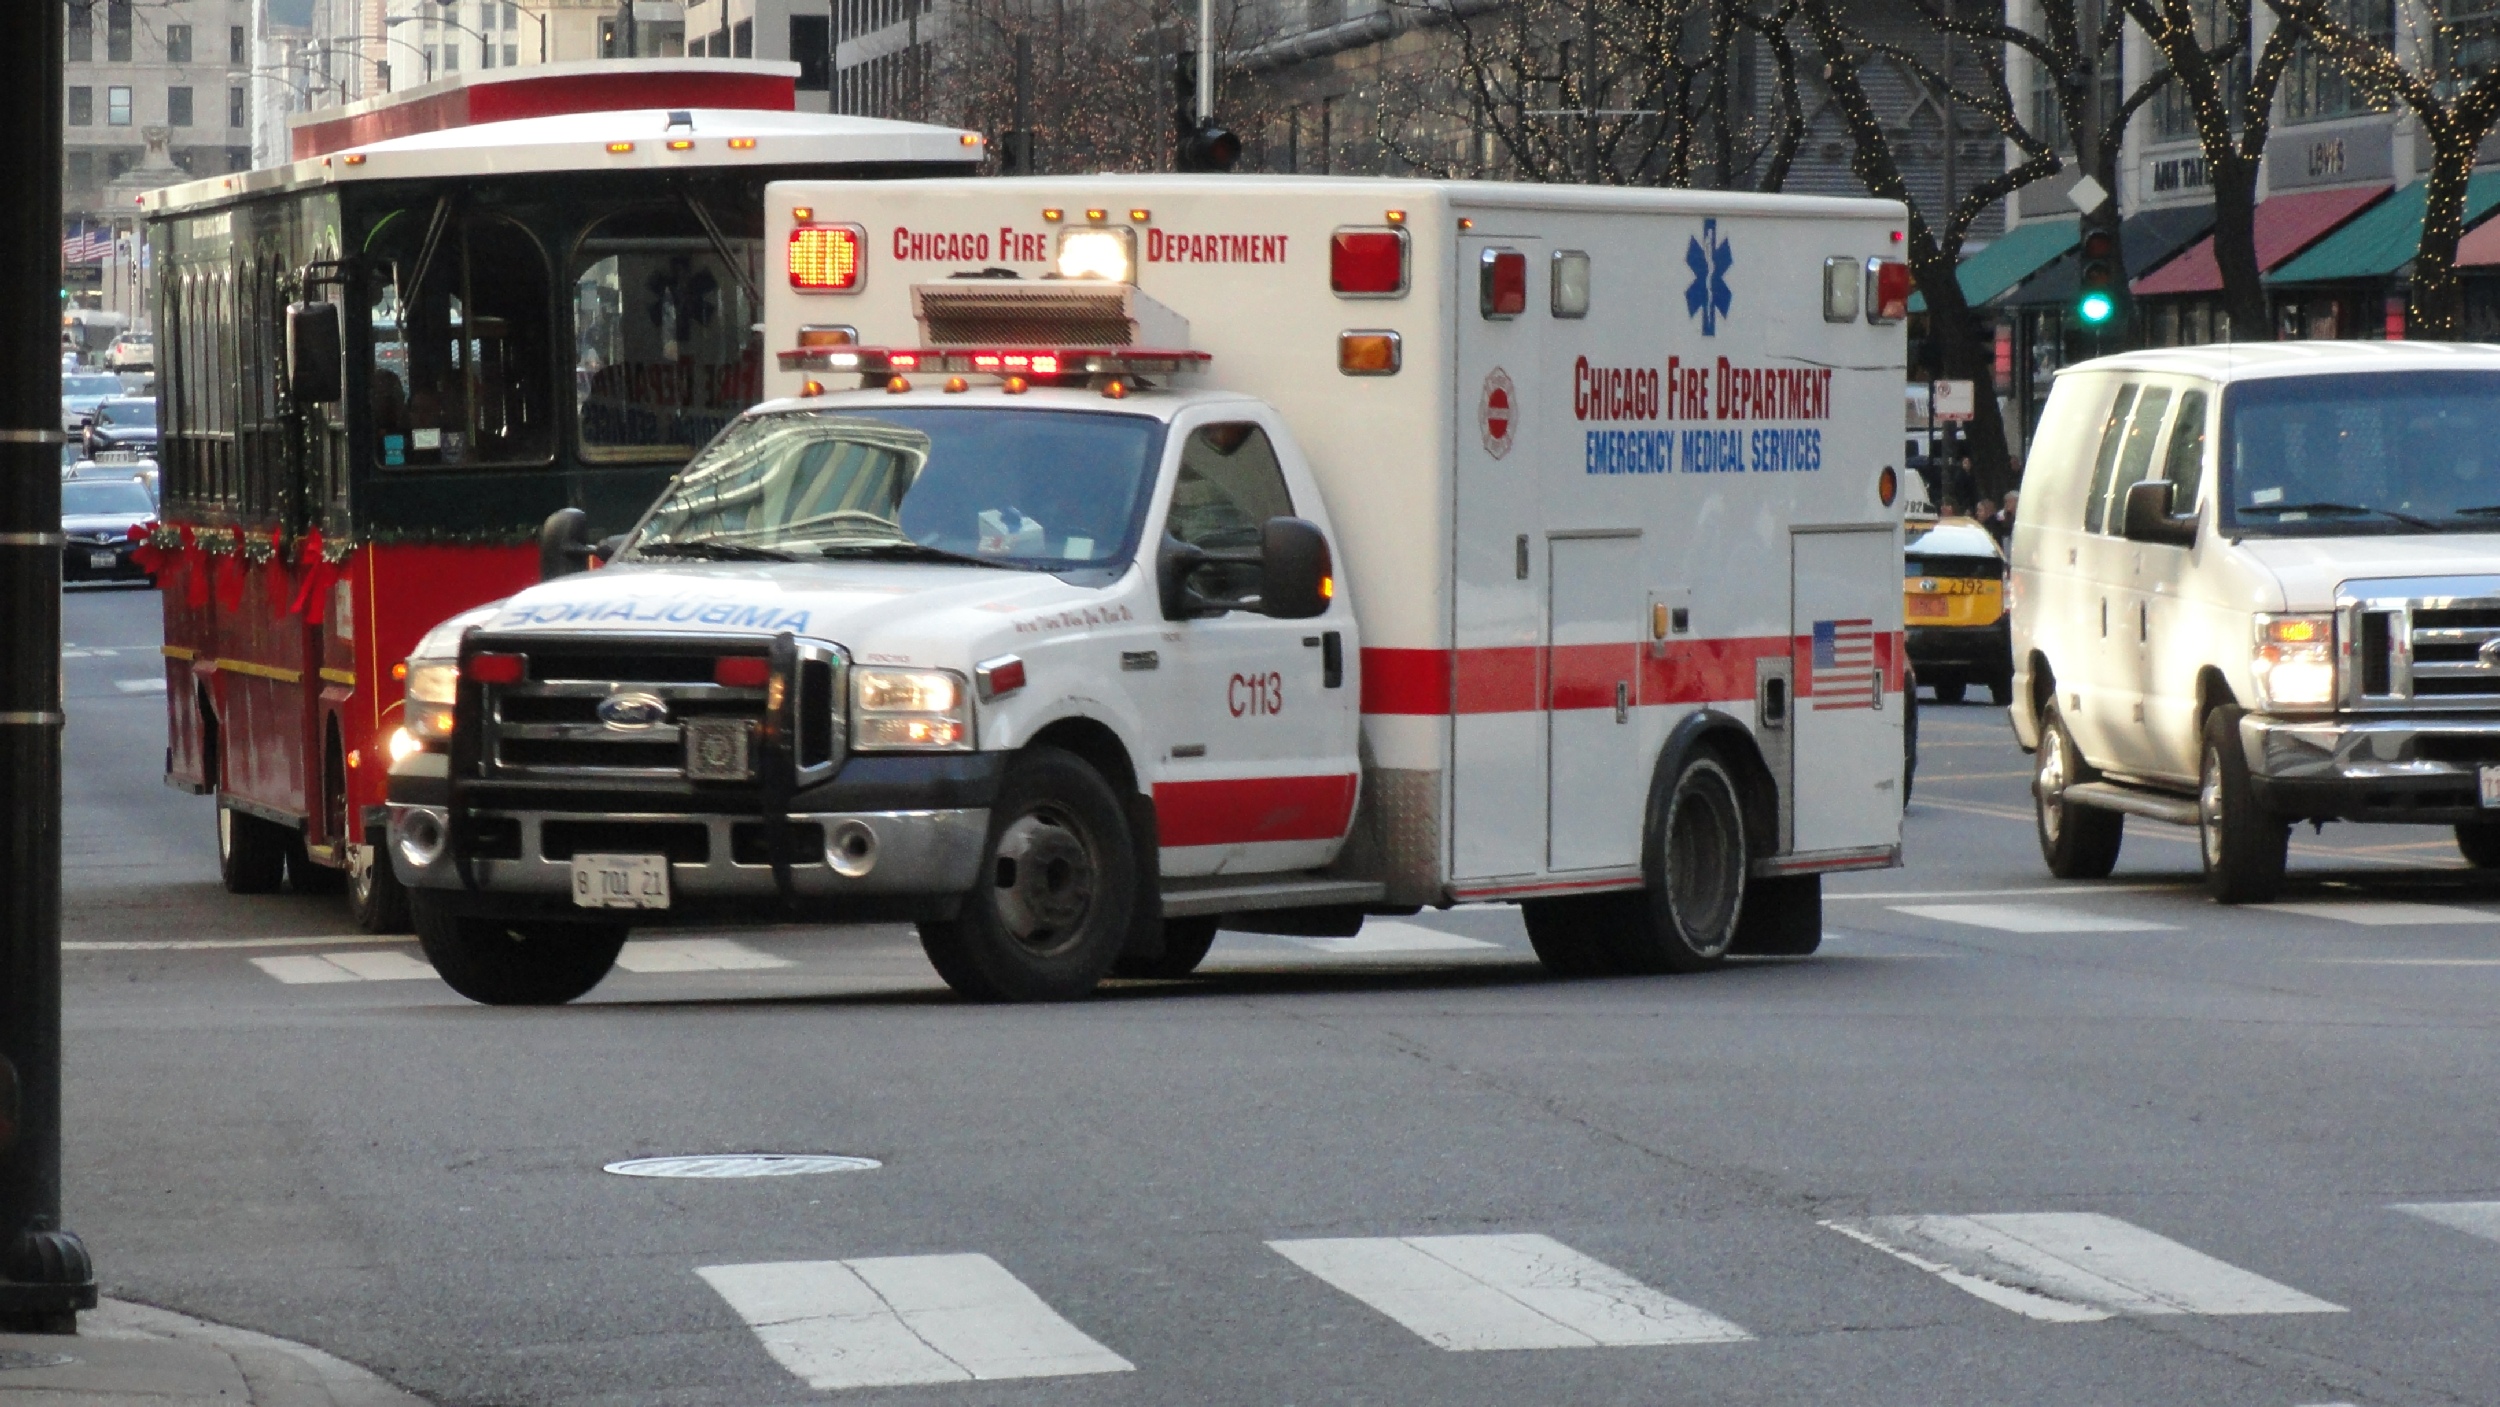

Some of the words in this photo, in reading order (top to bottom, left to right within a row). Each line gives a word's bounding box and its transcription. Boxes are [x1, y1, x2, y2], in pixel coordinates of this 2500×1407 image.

[893, 227, 989, 262] CHICAGO
[1000, 227, 1047, 262] FIRE
[1147, 228, 1289, 263] DEPARTMENT
[1574, 354, 1659, 421] CHICAGO
[1667, 354, 1709, 421] FIRE
[1717, 355, 1832, 421] DEPARTMENT
[1586, 429, 1675, 474] EMERGENCY
[1681, 429, 1745, 473] MEDICAL
[1752, 428, 1821, 472] SERVICES
[1228, 670, 1283, 718] C113
